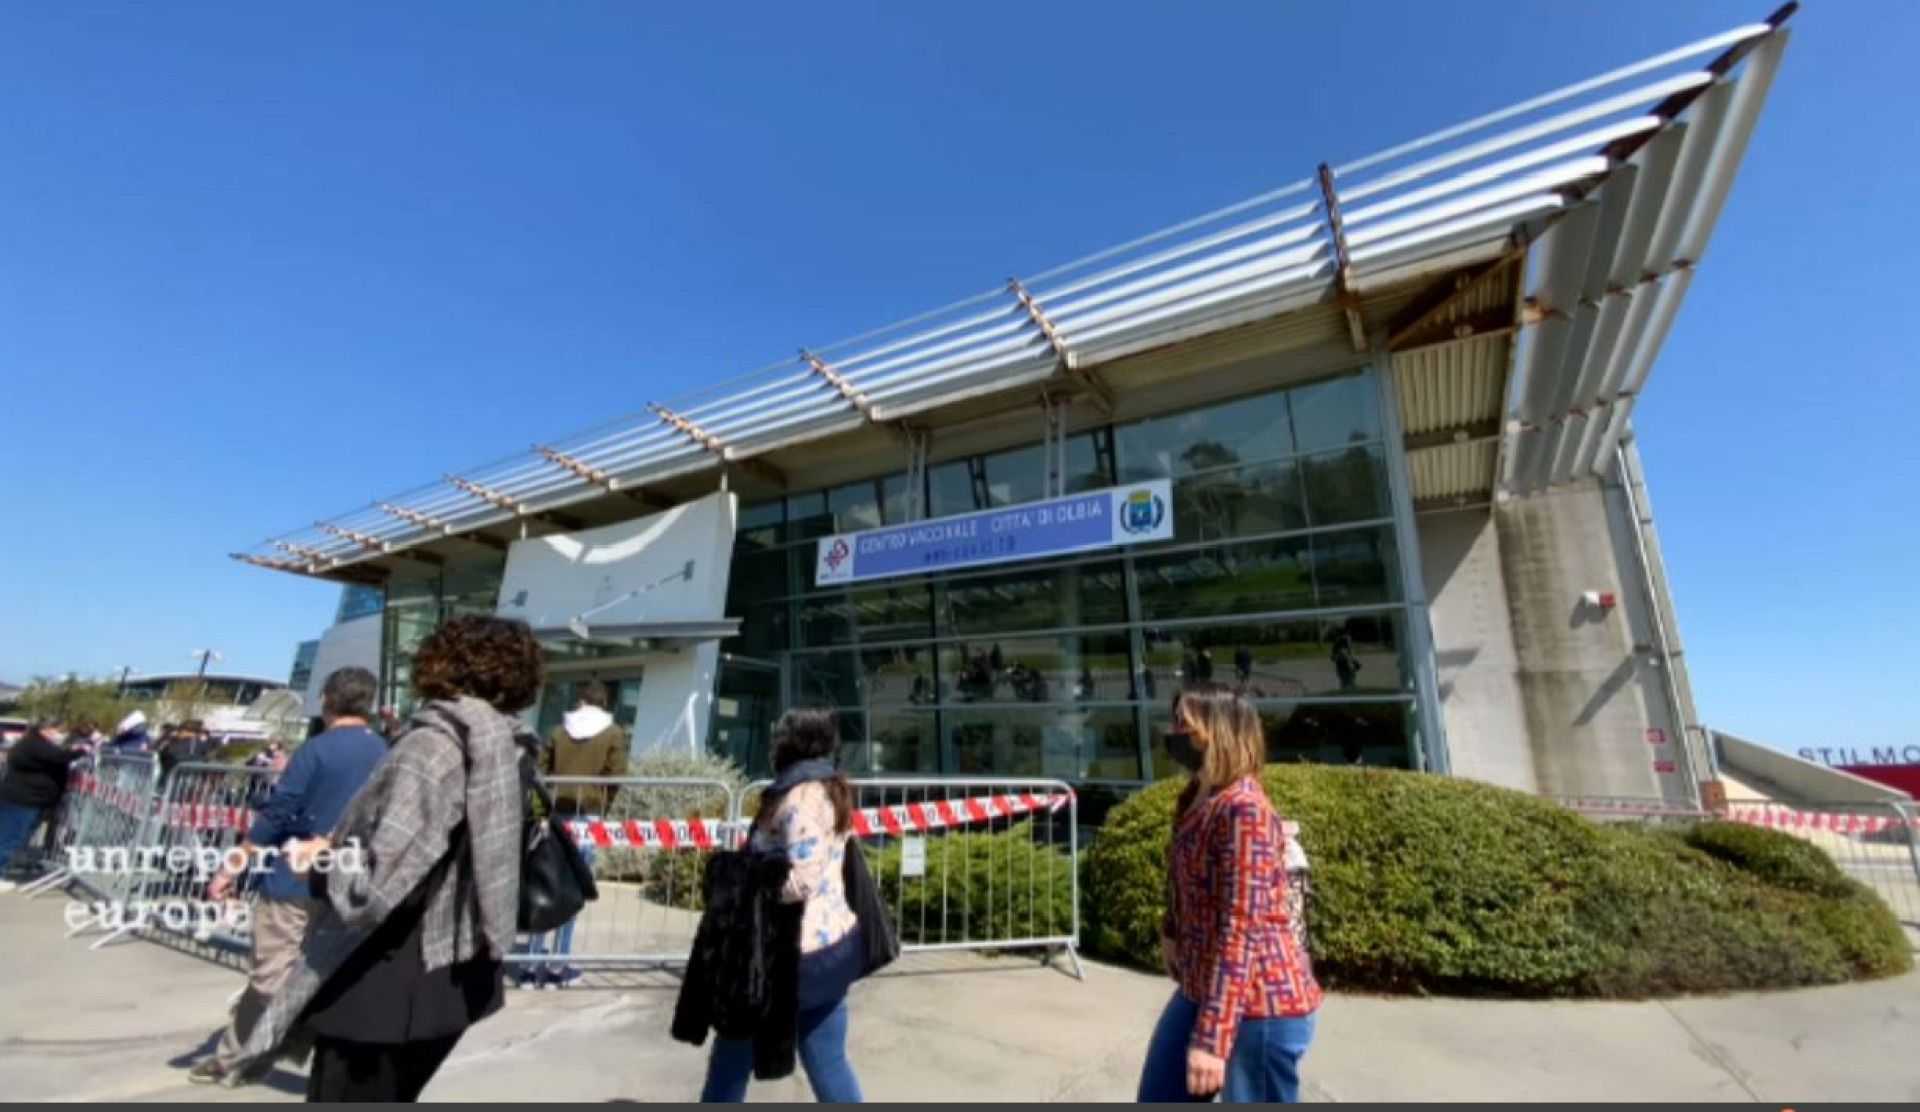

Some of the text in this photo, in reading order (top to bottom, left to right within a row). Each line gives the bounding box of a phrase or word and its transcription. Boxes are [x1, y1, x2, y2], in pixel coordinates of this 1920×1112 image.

[861, 533, 906, 554] CENTRO
[1038, 508, 1053, 525] DI
[1056, 501, 1102, 523] OLBIA
